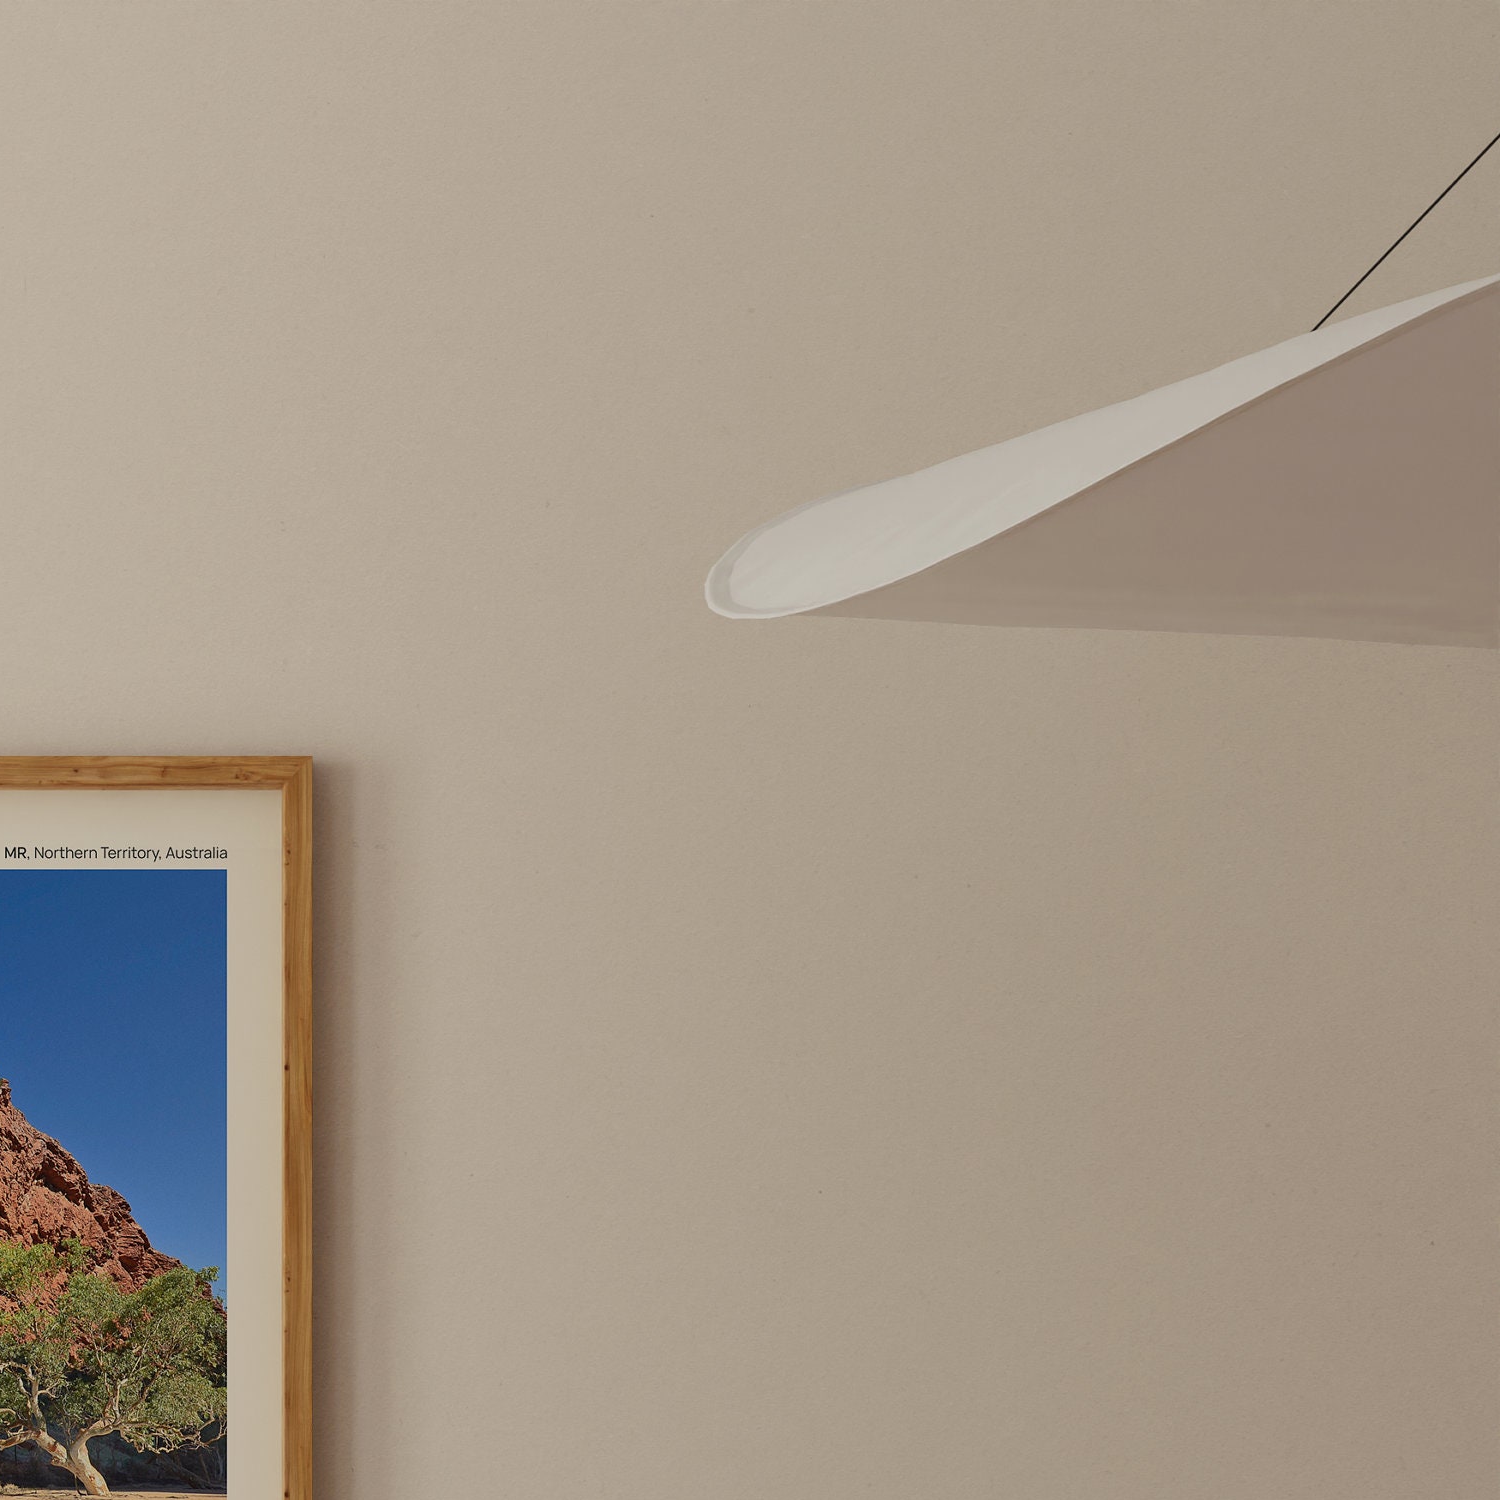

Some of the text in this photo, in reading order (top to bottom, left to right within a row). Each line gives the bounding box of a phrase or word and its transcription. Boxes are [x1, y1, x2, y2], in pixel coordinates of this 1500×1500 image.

[4, 846, 228, 863] MR, Northern Territory, Australia
